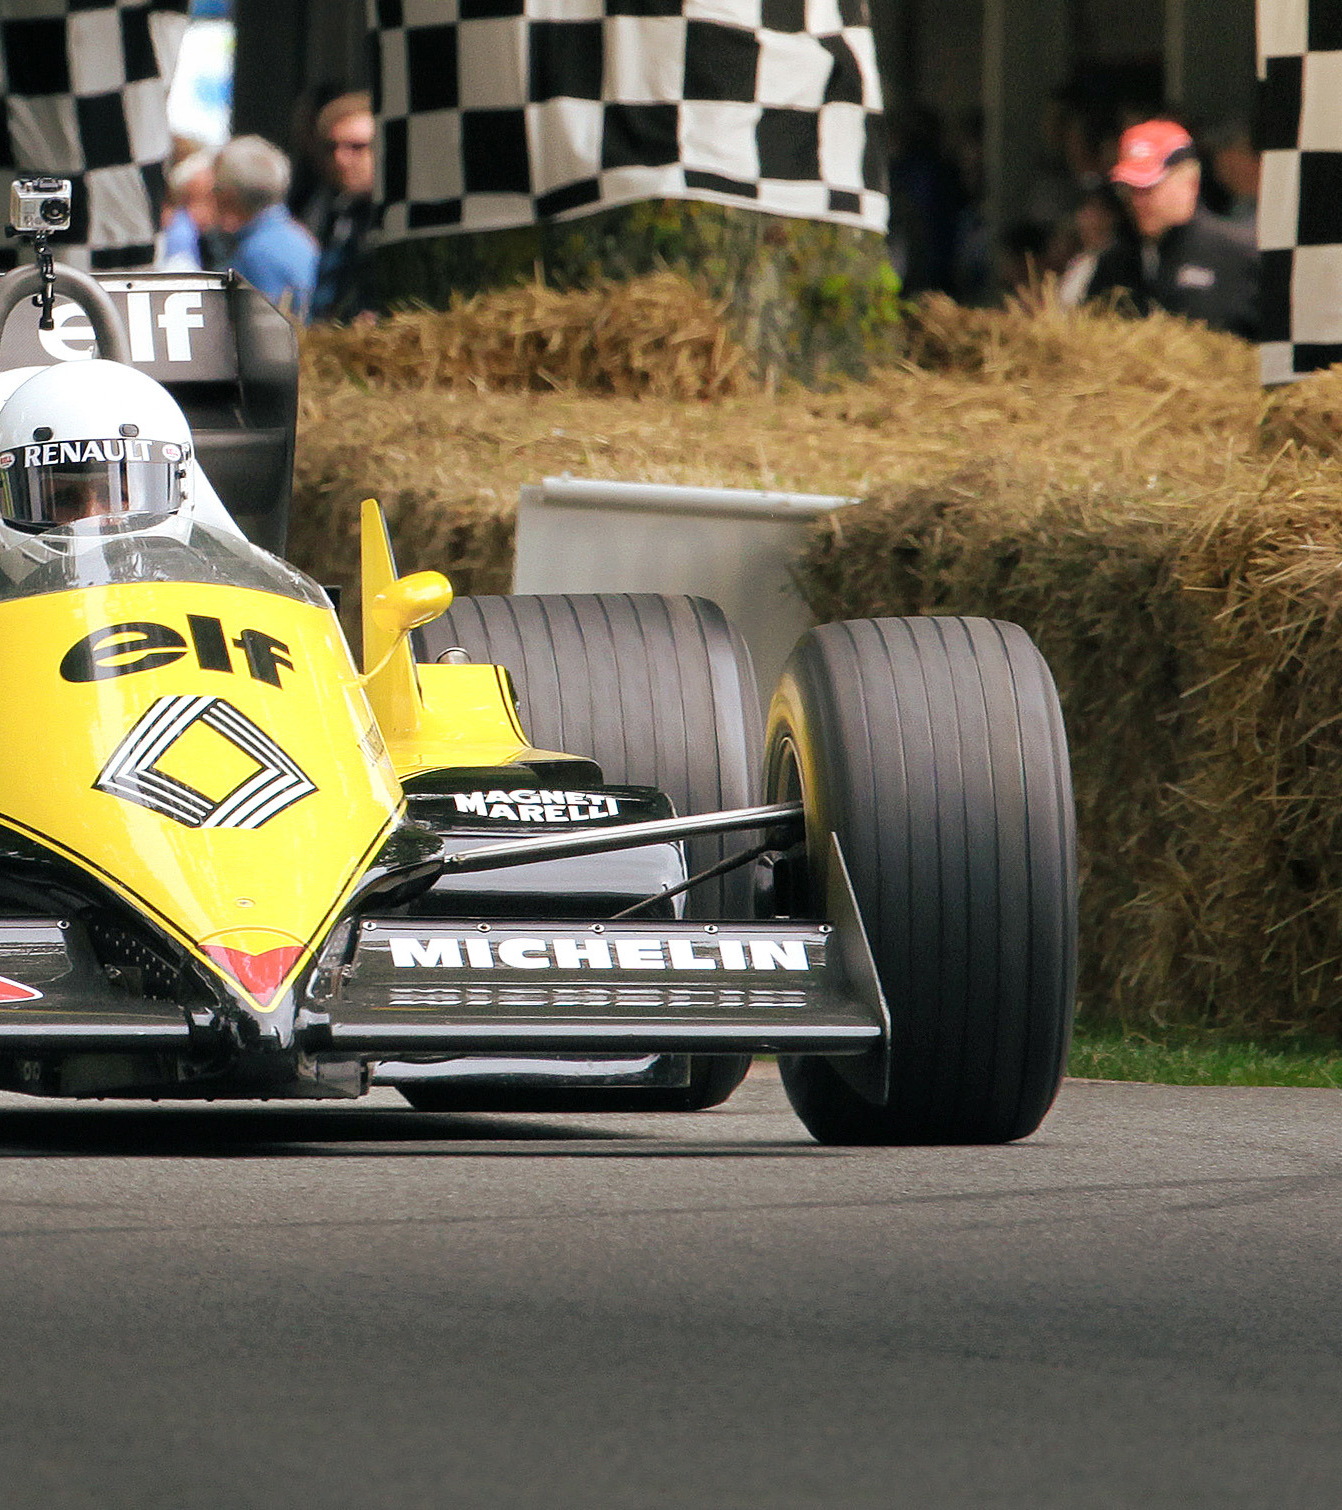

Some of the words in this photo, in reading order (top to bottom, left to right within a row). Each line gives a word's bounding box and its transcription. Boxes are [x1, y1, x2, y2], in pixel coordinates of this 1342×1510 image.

[24, 439, 153, 468] RENAULT
[59, 613, 295, 690] elf
[389, 937, 811, 971] MICHELIN
